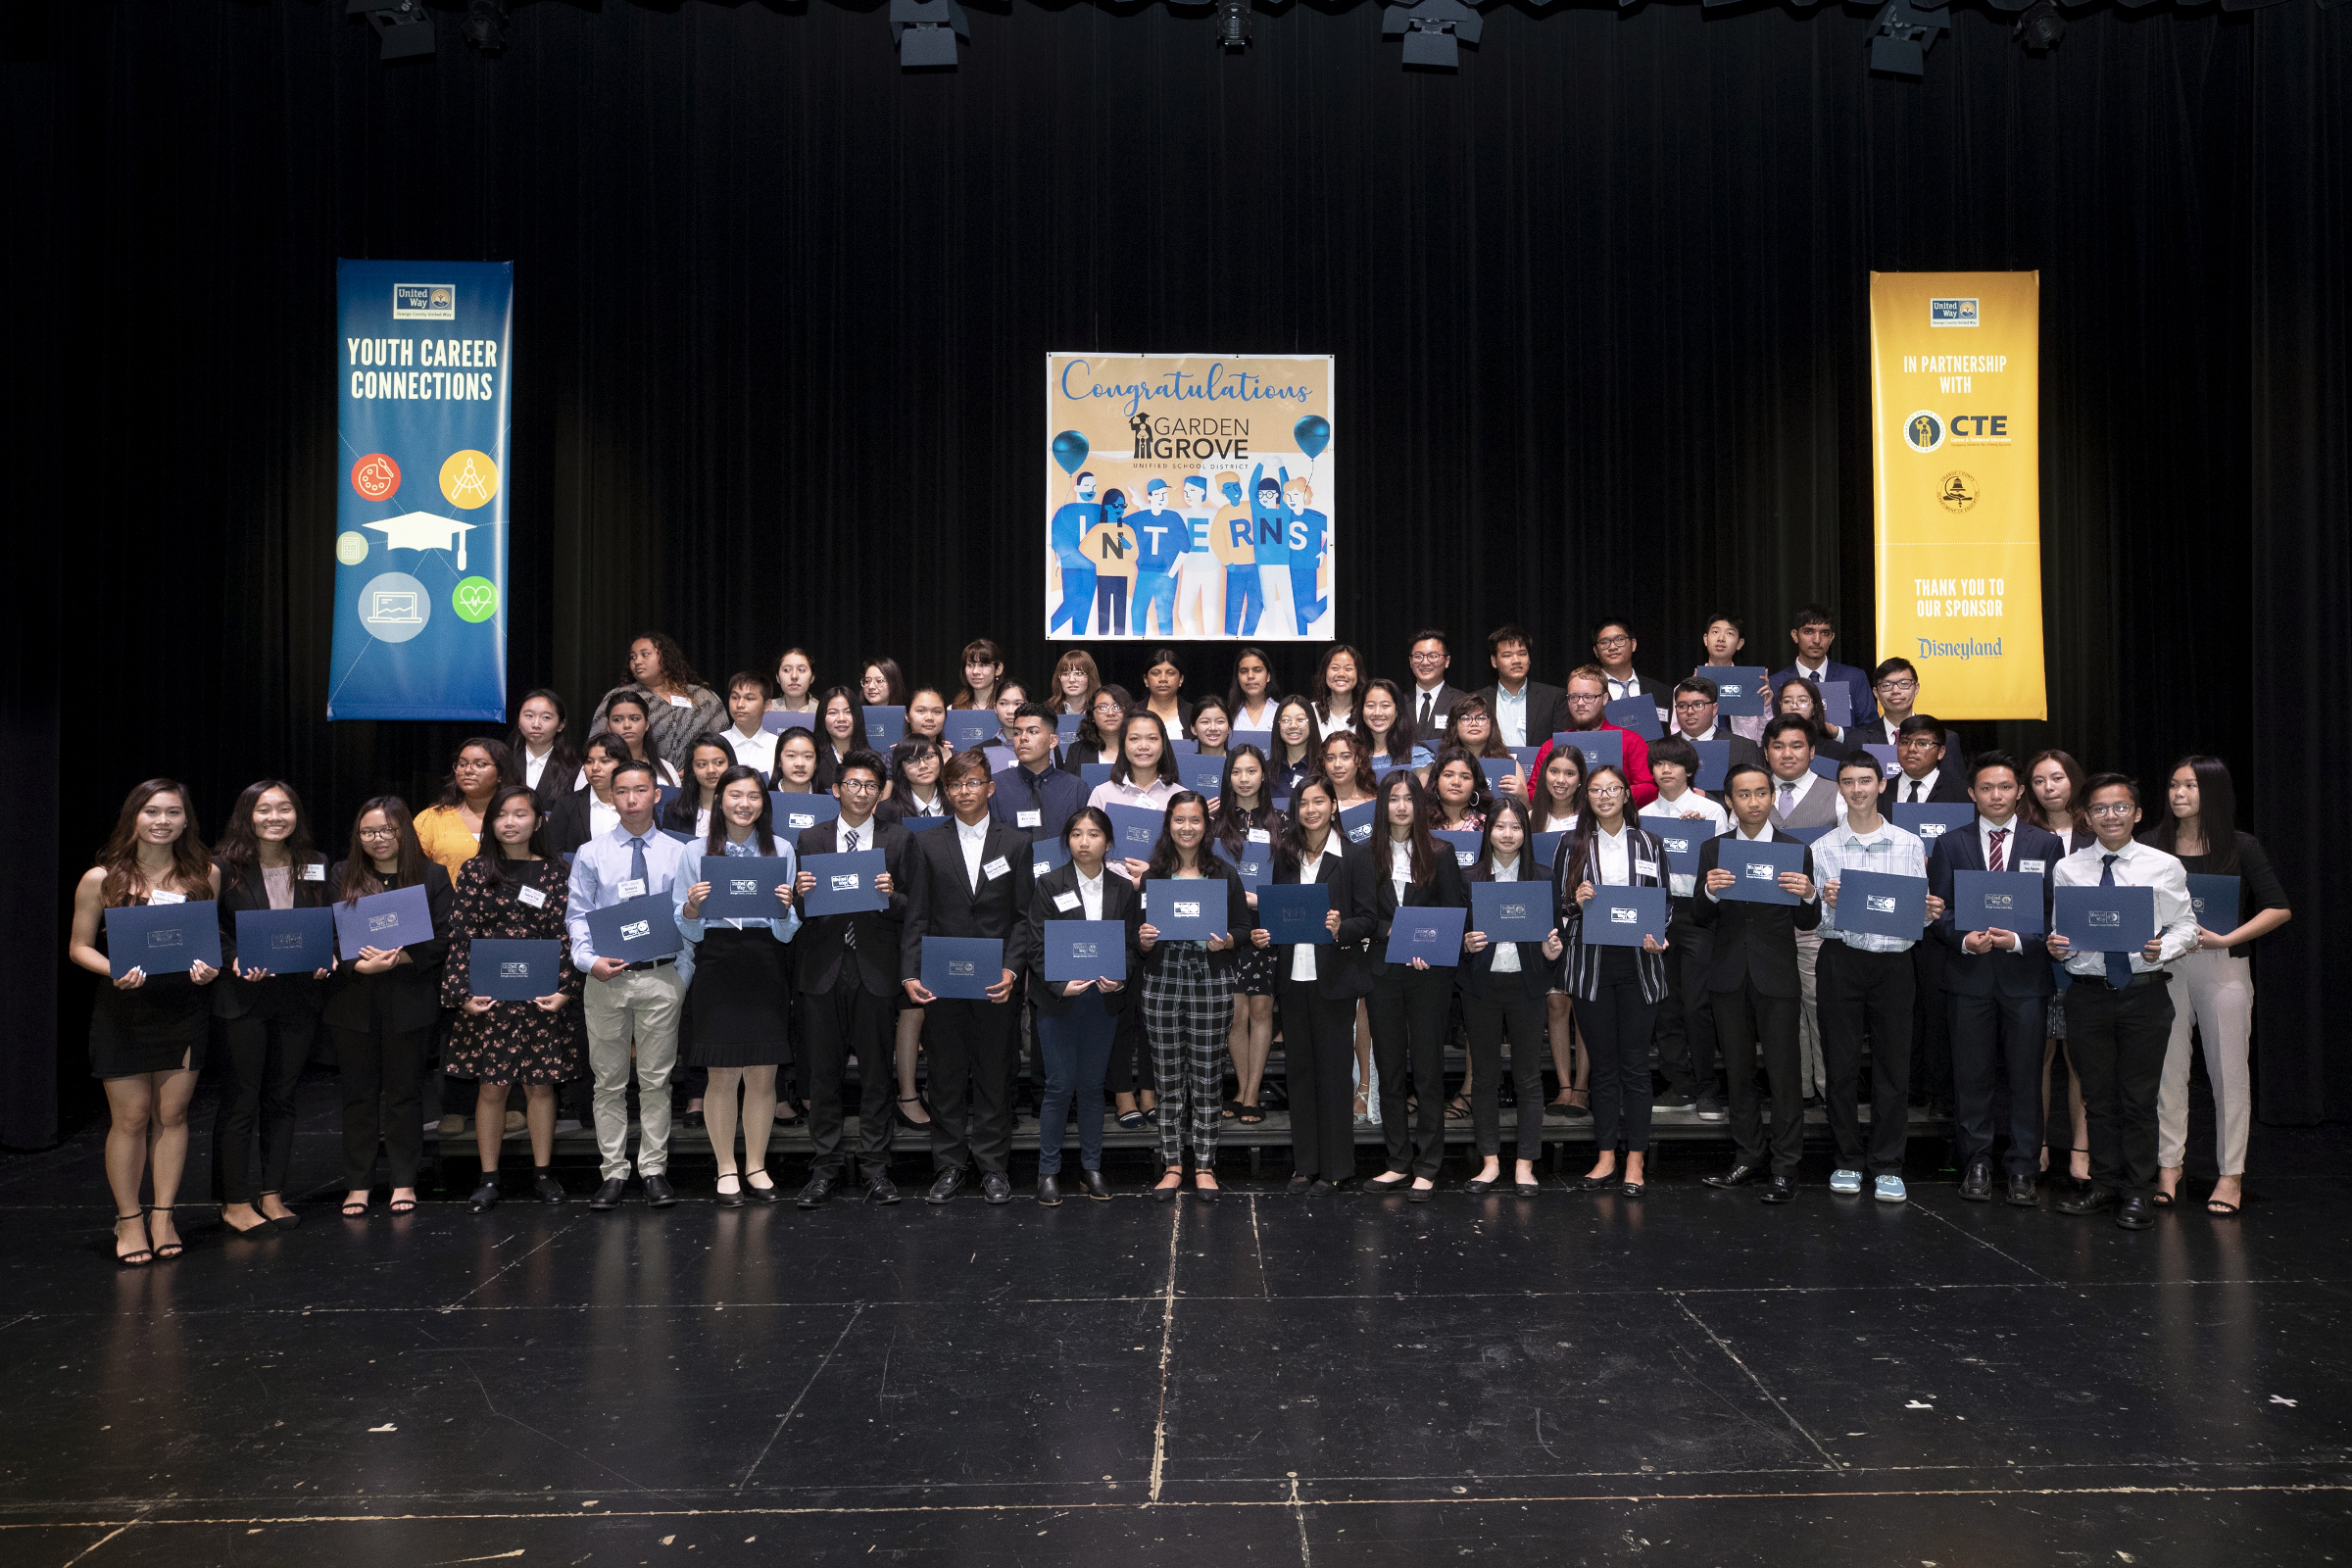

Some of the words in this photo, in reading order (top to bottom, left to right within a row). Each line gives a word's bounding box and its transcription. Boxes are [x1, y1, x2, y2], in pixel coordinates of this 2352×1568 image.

[398, 288, 428, 298] United
[410, 297, 427, 309] Way
[1942, 310, 1958, 318] Way
[347, 338, 414, 367] YOUTH
[420, 339, 498, 368] CAREER
[1903, 356, 1917, 372] IN
[1921, 355, 2007, 372] PARTNERSHIP
[351, 370, 493, 401] CONNECTIONS
[1061, 359, 1312, 417] Congratulations
[1939, 376, 1972, 393] WITH
[1154, 417, 1250, 436] GARDEN
[1950, 416, 2007, 436] CTE
[1154, 438, 1249, 460] GROVE
[1914, 578, 1957, 597] THANK
[1960, 578, 1984, 596] YOU
[1988, 578, 2005, 596] TO
[1917, 600, 1941, 617] OUR
[1945, 599, 2003, 617] SPONSOR
[1916, 637, 2002, 662] Disneyland
